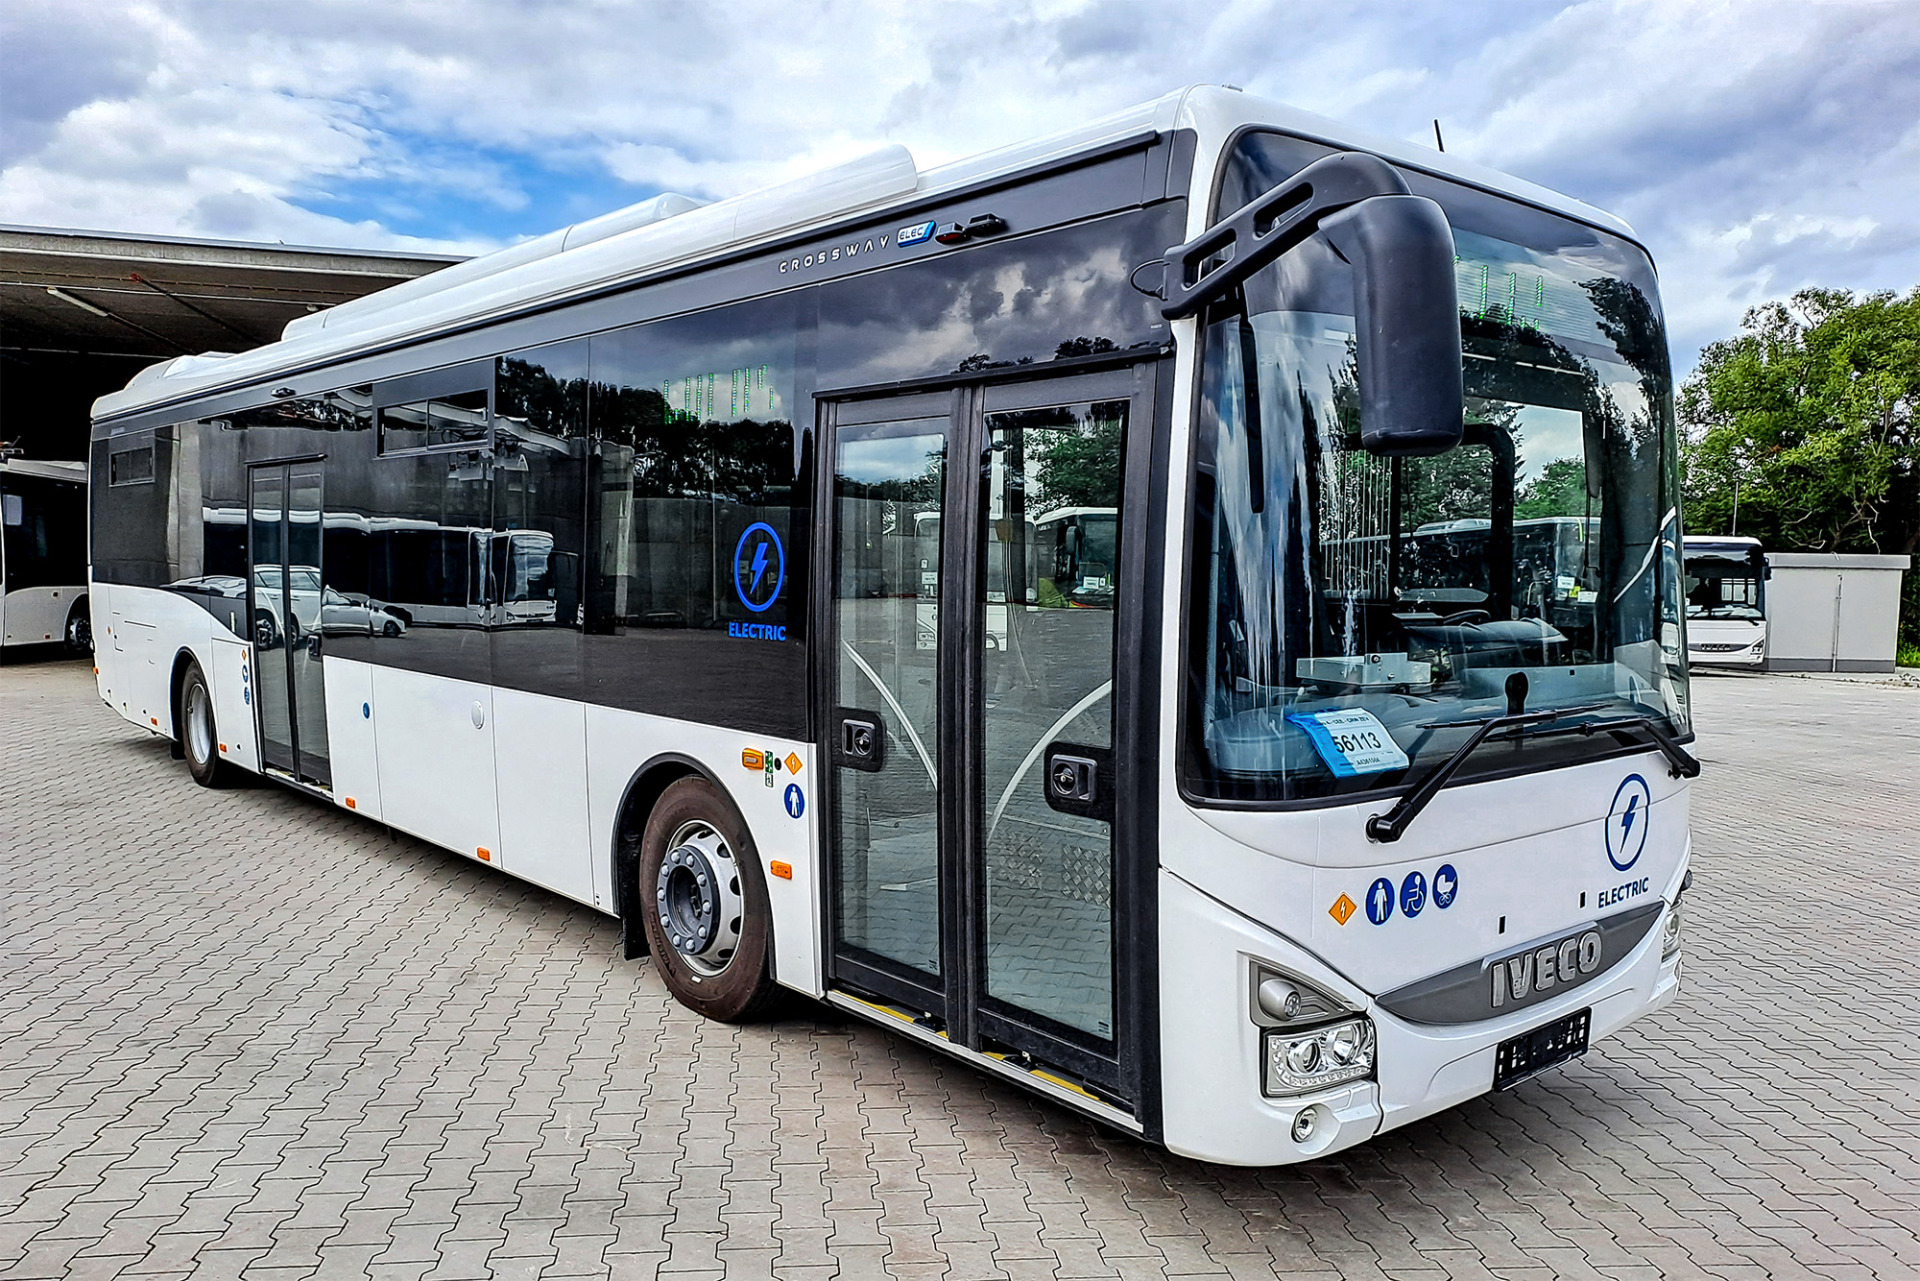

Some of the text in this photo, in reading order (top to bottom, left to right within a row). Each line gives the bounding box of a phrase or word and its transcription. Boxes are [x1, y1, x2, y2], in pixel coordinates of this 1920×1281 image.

[778, 227, 925, 274] CROSSWAY ELEC
[728, 621, 787, 642] ELECTRIC
[1331, 731, 1382, 754] 56113
[1597, 876, 1650, 909] ELECTRIC
[1490, 931, 1602, 1008] IVECO
